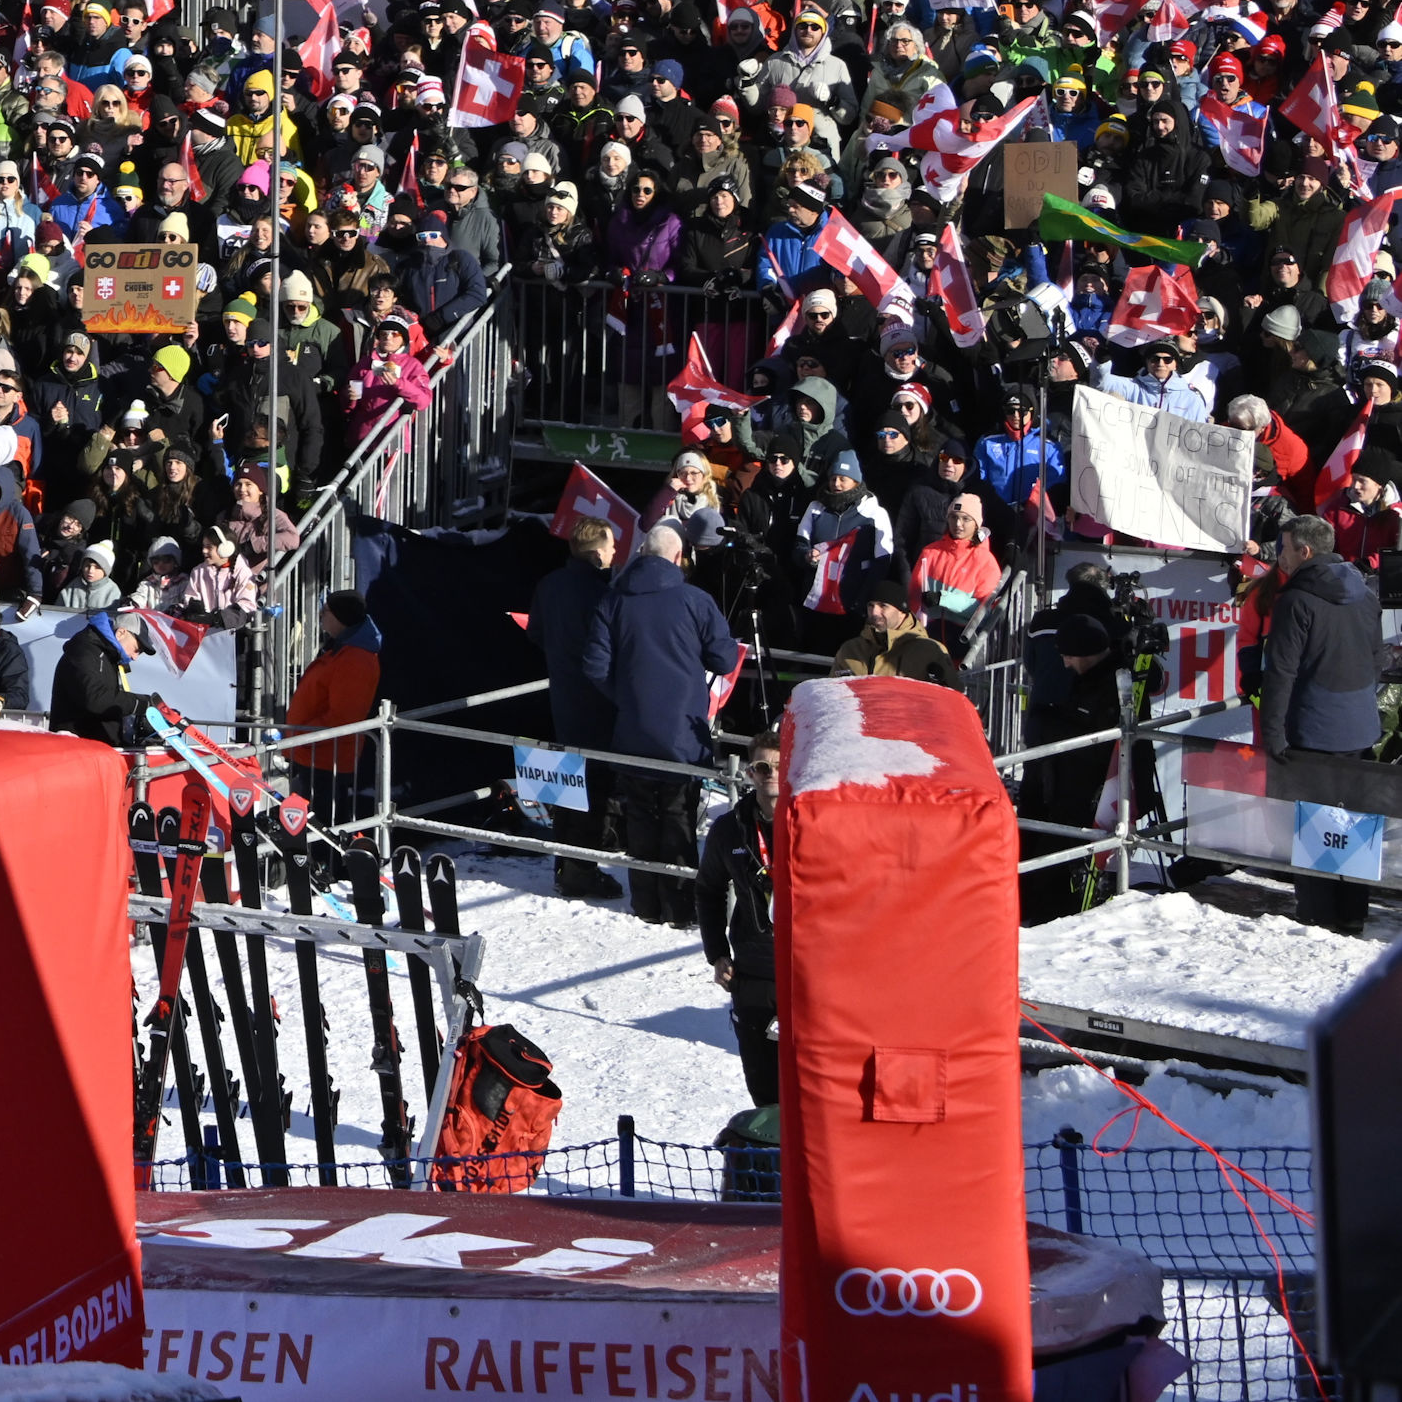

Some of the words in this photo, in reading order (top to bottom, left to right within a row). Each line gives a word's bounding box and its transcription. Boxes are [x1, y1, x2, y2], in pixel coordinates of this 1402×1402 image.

[1027, 181, 1045, 191] DU
[86, 251, 116, 269] GO
[163, 251, 193, 268] GO
[1167, 421, 1245, 459] HOPP
[1175, 465, 1196, 485] OF
[516, 765, 558, 786] VIAPLAY
[561, 775, 585, 788] NOR
[1323, 831, 1348, 850] SRF
[423, 1336, 781, 1402] RAIFFEISEN
